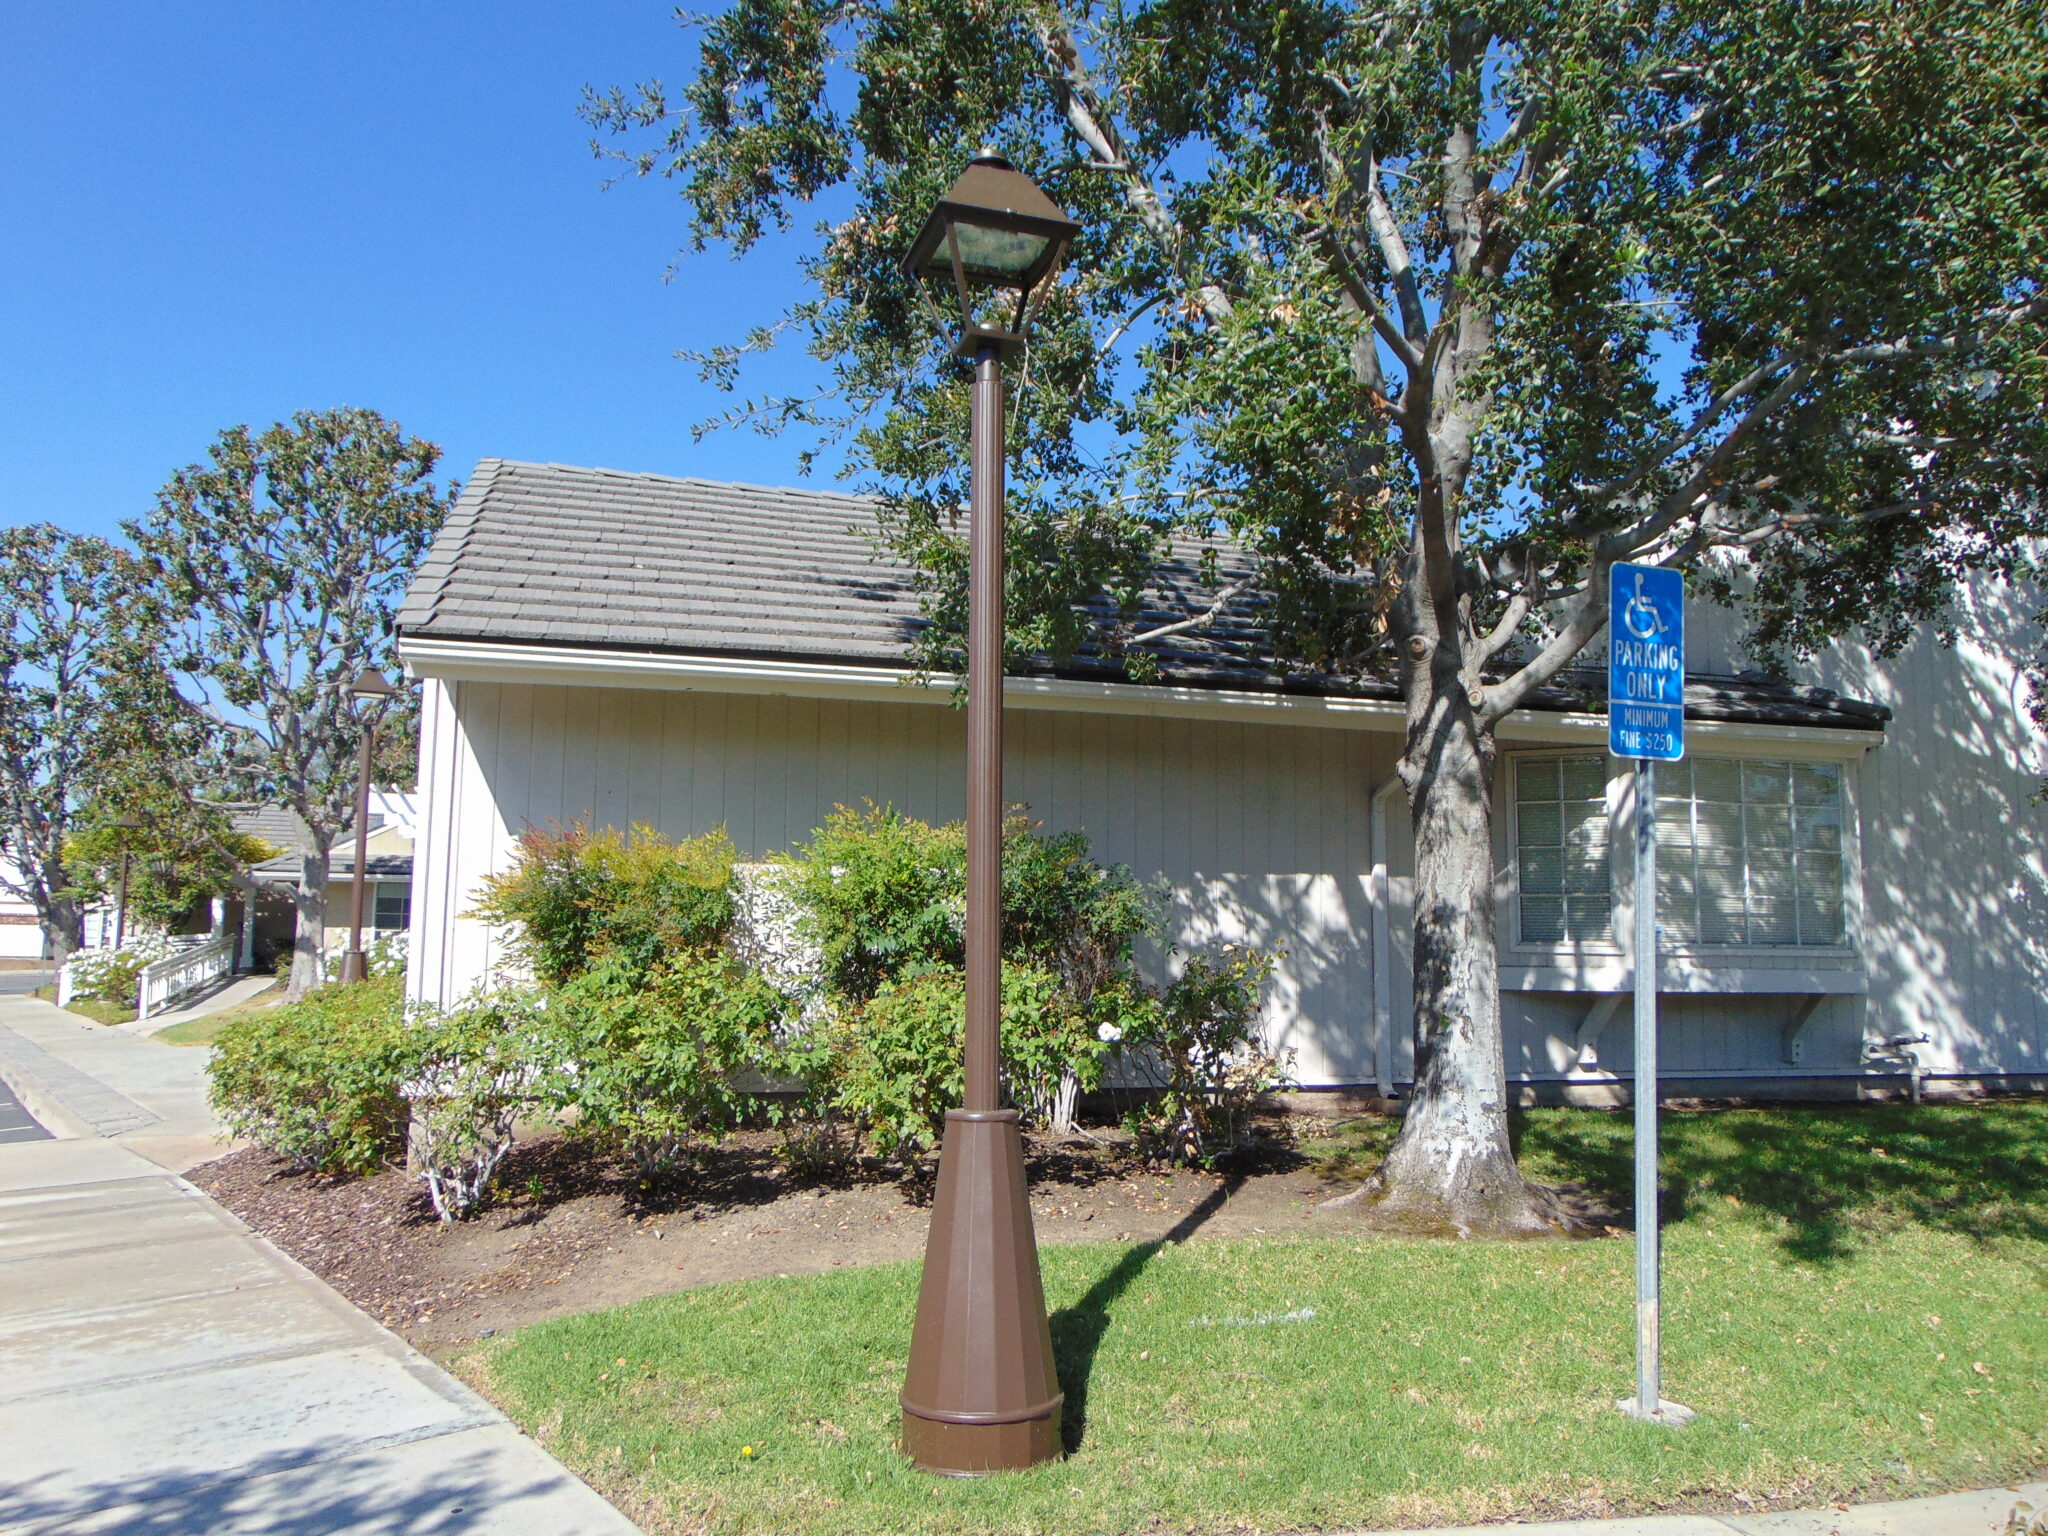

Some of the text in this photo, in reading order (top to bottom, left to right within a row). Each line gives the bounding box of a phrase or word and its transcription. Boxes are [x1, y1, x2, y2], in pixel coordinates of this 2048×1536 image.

[1615, 639, 1679, 671] PARKING
[1626, 671, 1666, 700] ONLY
[1624, 708, 1669, 728] MINIMUM
[1619, 729, 1673, 752] FINE $250
